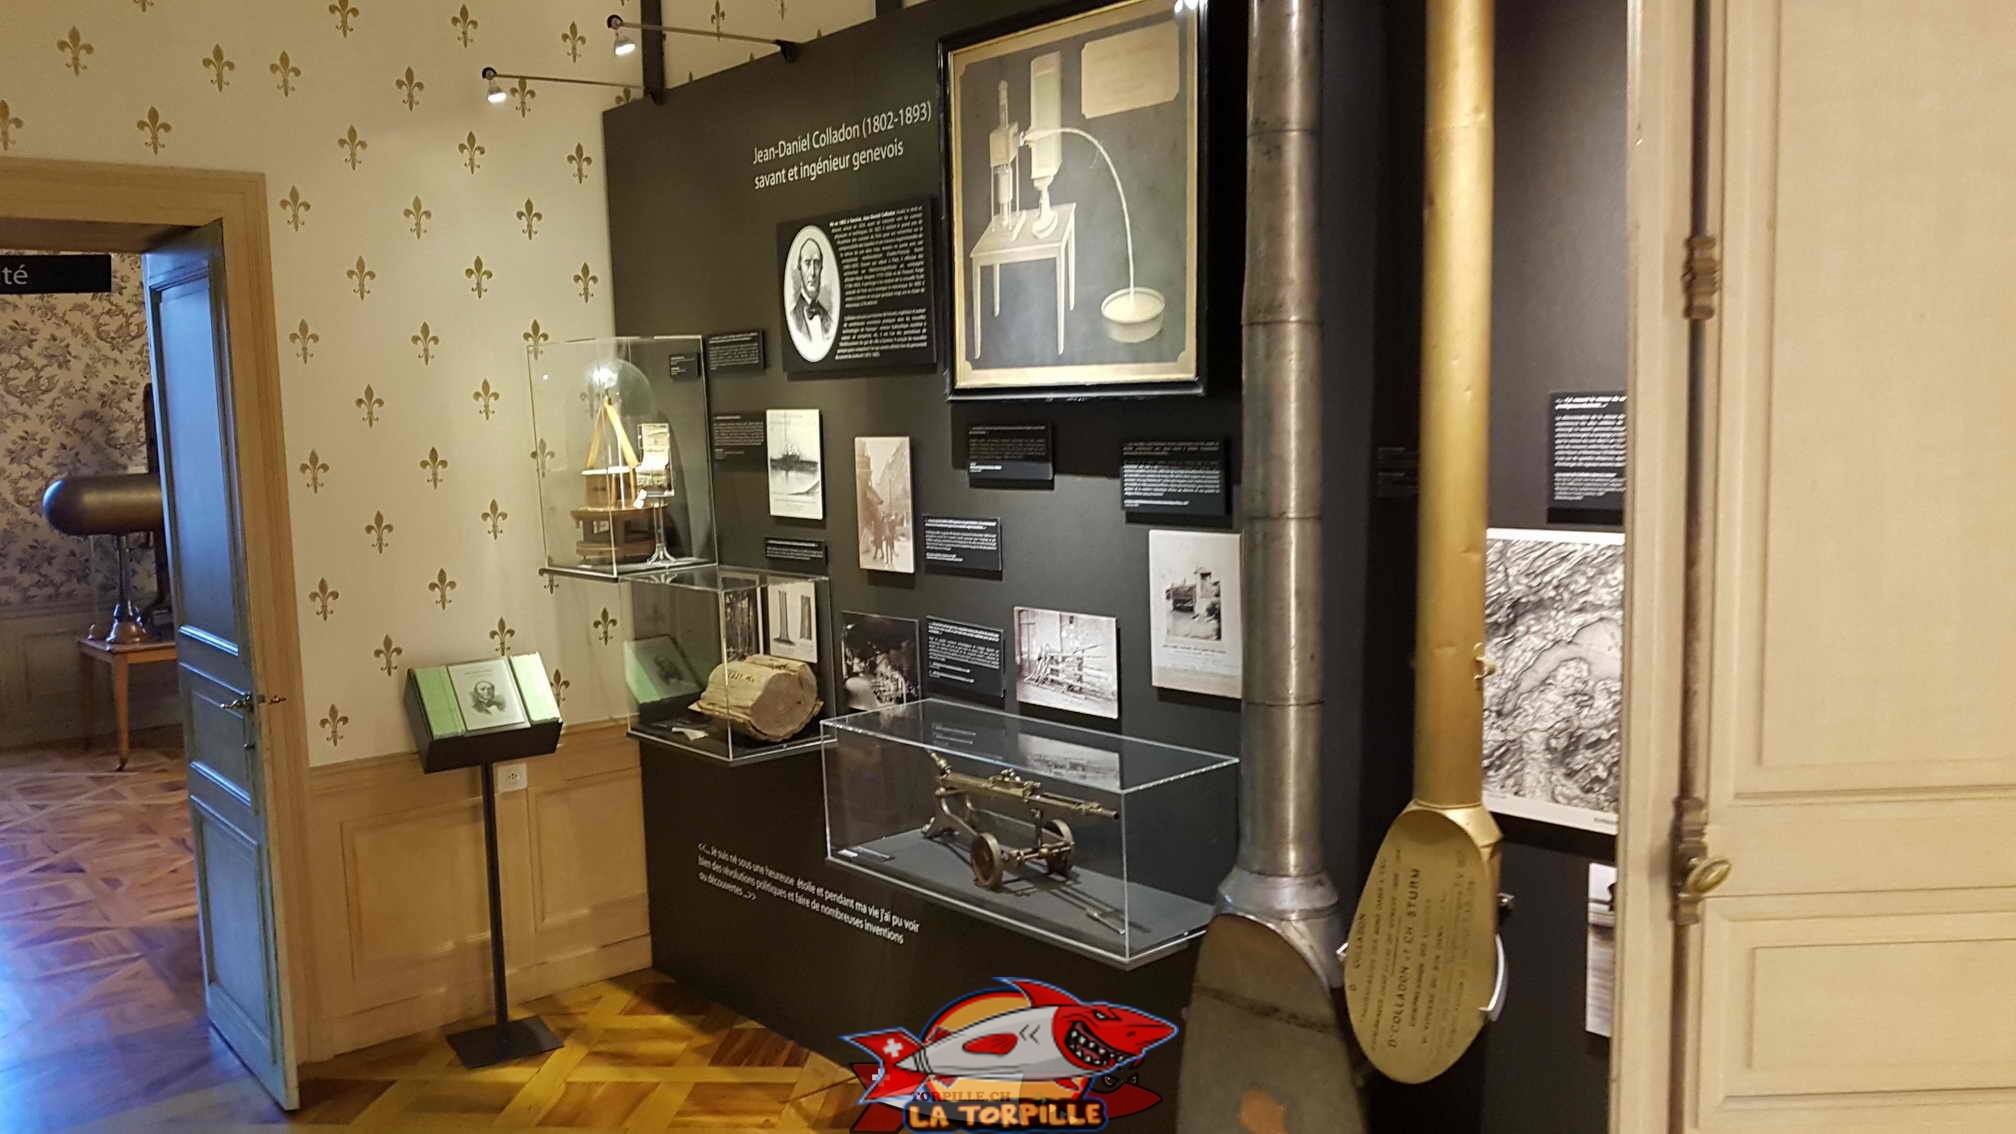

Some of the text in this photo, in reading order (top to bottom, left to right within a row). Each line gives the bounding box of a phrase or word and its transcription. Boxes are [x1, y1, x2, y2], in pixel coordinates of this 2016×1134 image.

[753, 101, 932, 164] Jean-Daniel Colladon (1802-1893)
[754, 137, 904, 190] savant et ingénieur genevois
[821, 904, 864, 929] nombreuses
[865, 918, 904, 945] inventions
[825, 890, 854, 910] pendant
[855, 902, 867, 914] ma
[868, 905, 879, 918] vie
[892, 915, 903, 927] pu
[904, 919, 920, 933] voir
